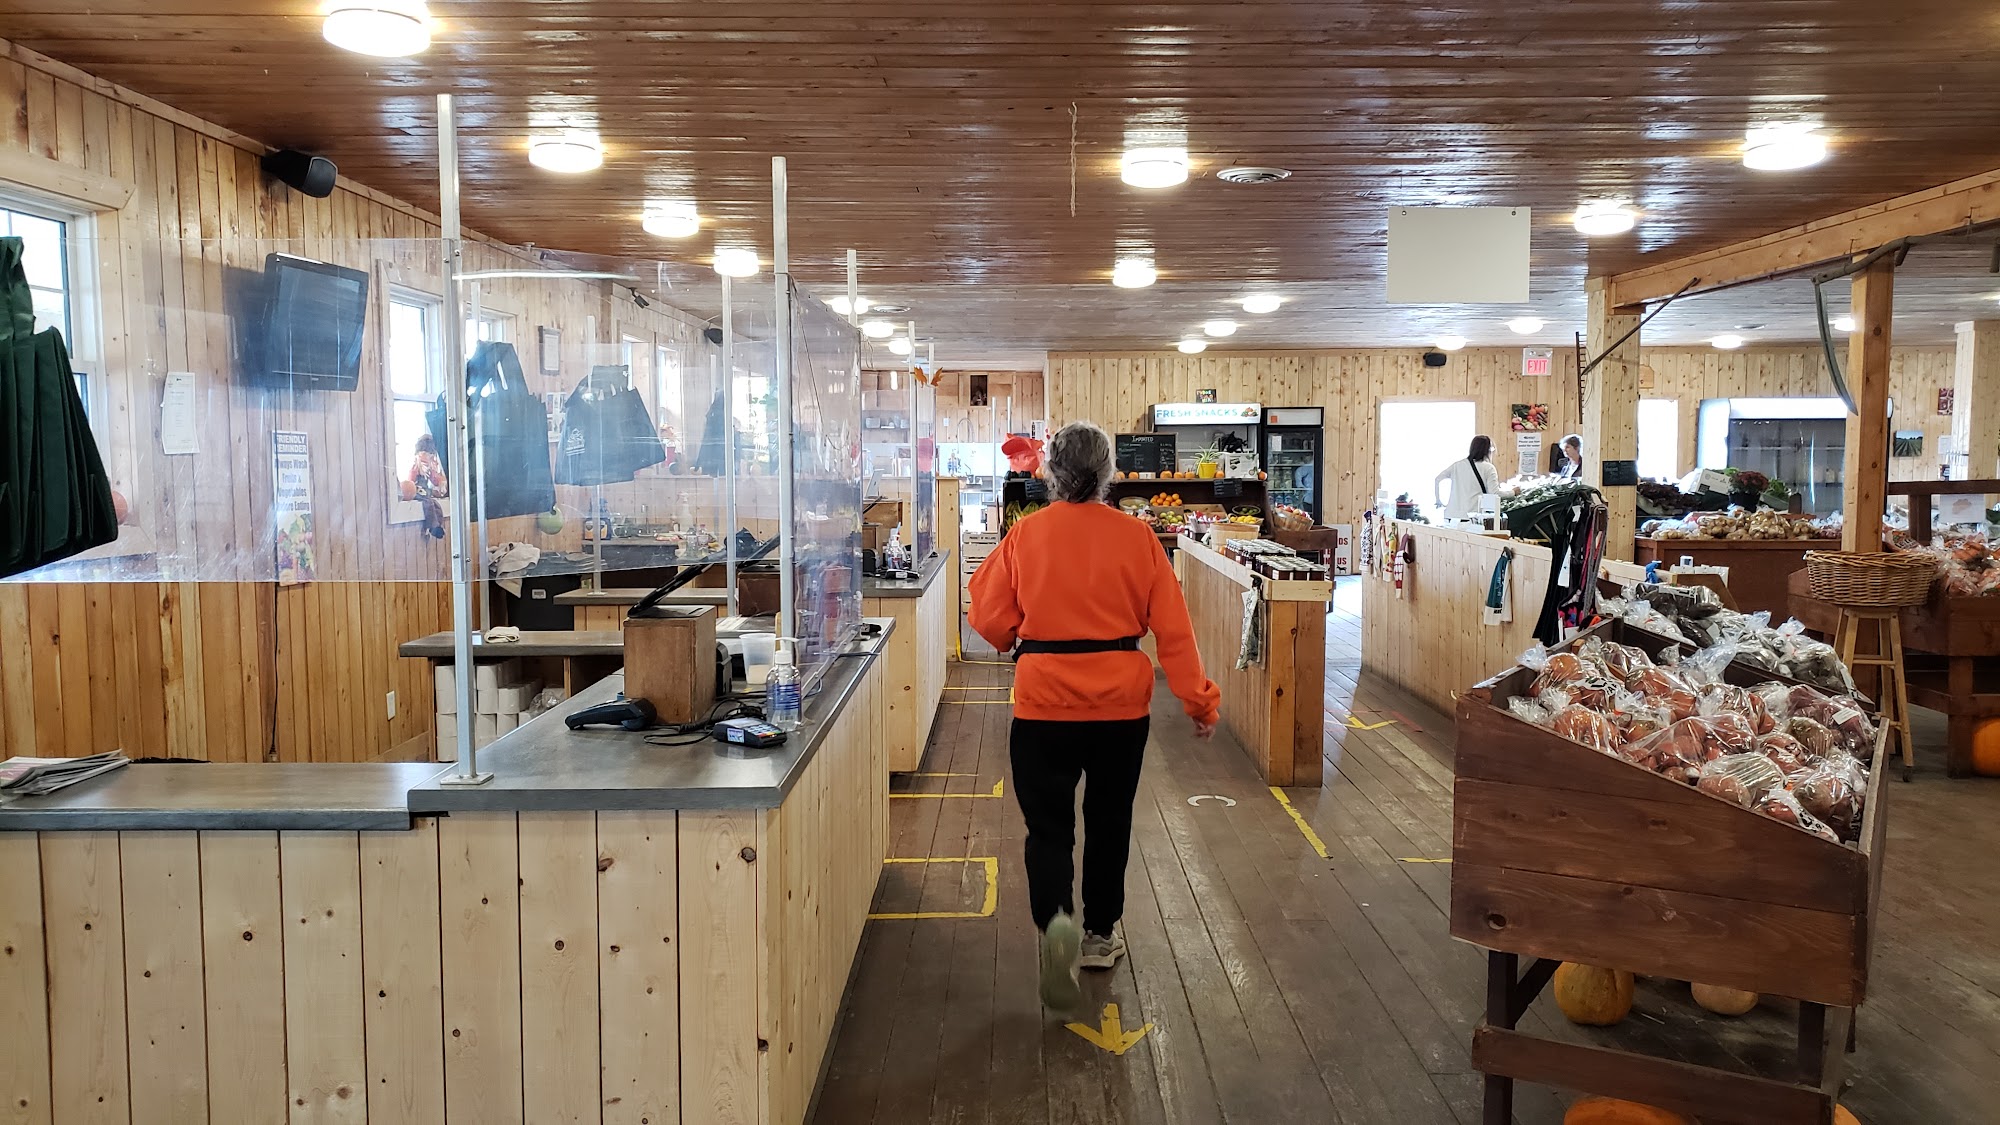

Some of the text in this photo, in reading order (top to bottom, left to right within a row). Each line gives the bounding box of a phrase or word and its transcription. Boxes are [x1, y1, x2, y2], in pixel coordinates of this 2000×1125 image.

[1527, 359, 1548, 374] EXIT
[1156, 408, 1238, 418] FRESH SNACKS
[275, 444, 307, 453] EMINDER
[275, 459, 292, 469] ways
